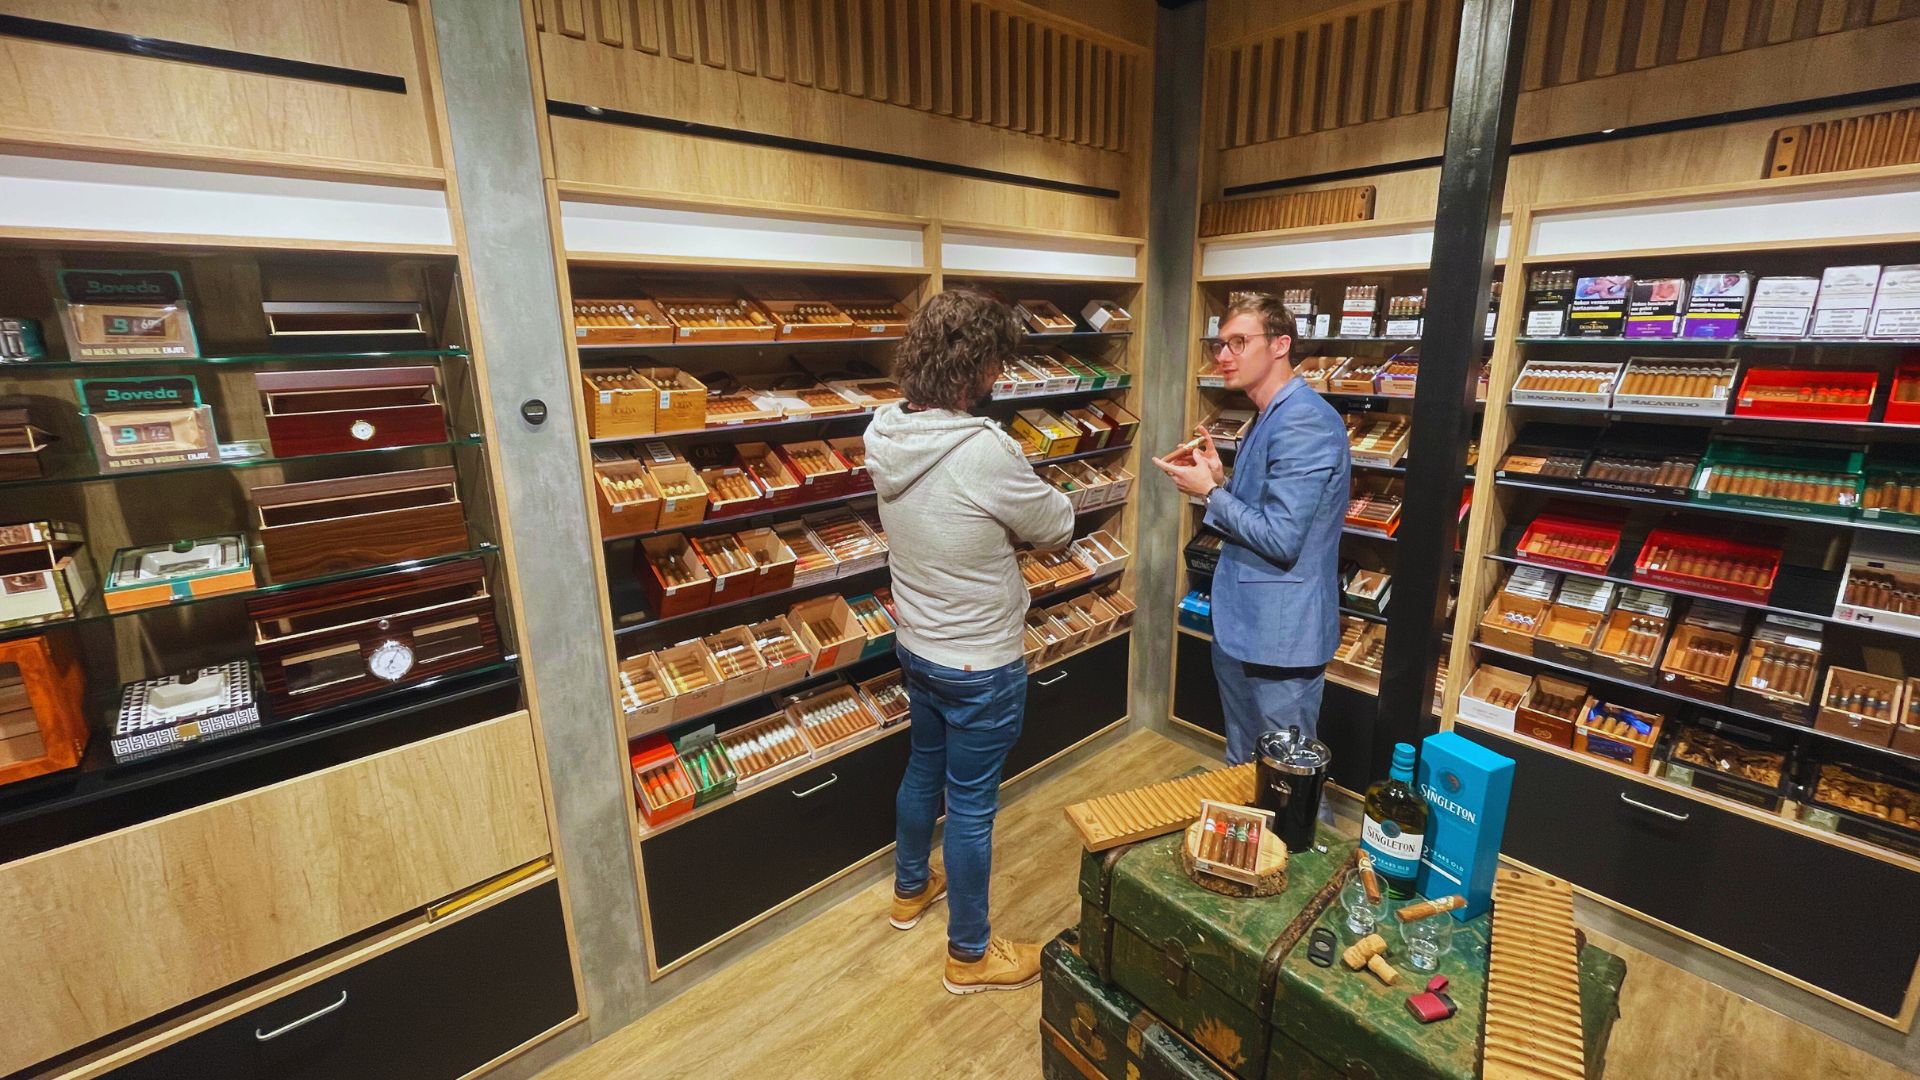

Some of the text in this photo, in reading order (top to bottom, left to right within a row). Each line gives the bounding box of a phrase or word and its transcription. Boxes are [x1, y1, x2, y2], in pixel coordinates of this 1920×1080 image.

[86, 280, 160, 293] Boveda
[104, 388, 178, 401] Boveda
[1526, 394, 1587, 403] MACANUDO
[1630, 398, 1700, 408] MACANUDO
[187, 452, 211, 460] ENJOY.
[1593, 483, 1656, 494] MACANUDO
[1420, 783, 1477, 825] SINGLETON
[1367, 826, 1416, 853] SINGLETON
[1377, 858, 1397, 869] YEARS
[1430, 848, 1450, 864] YEARS
[1450, 861, 1464, 872] OLD
